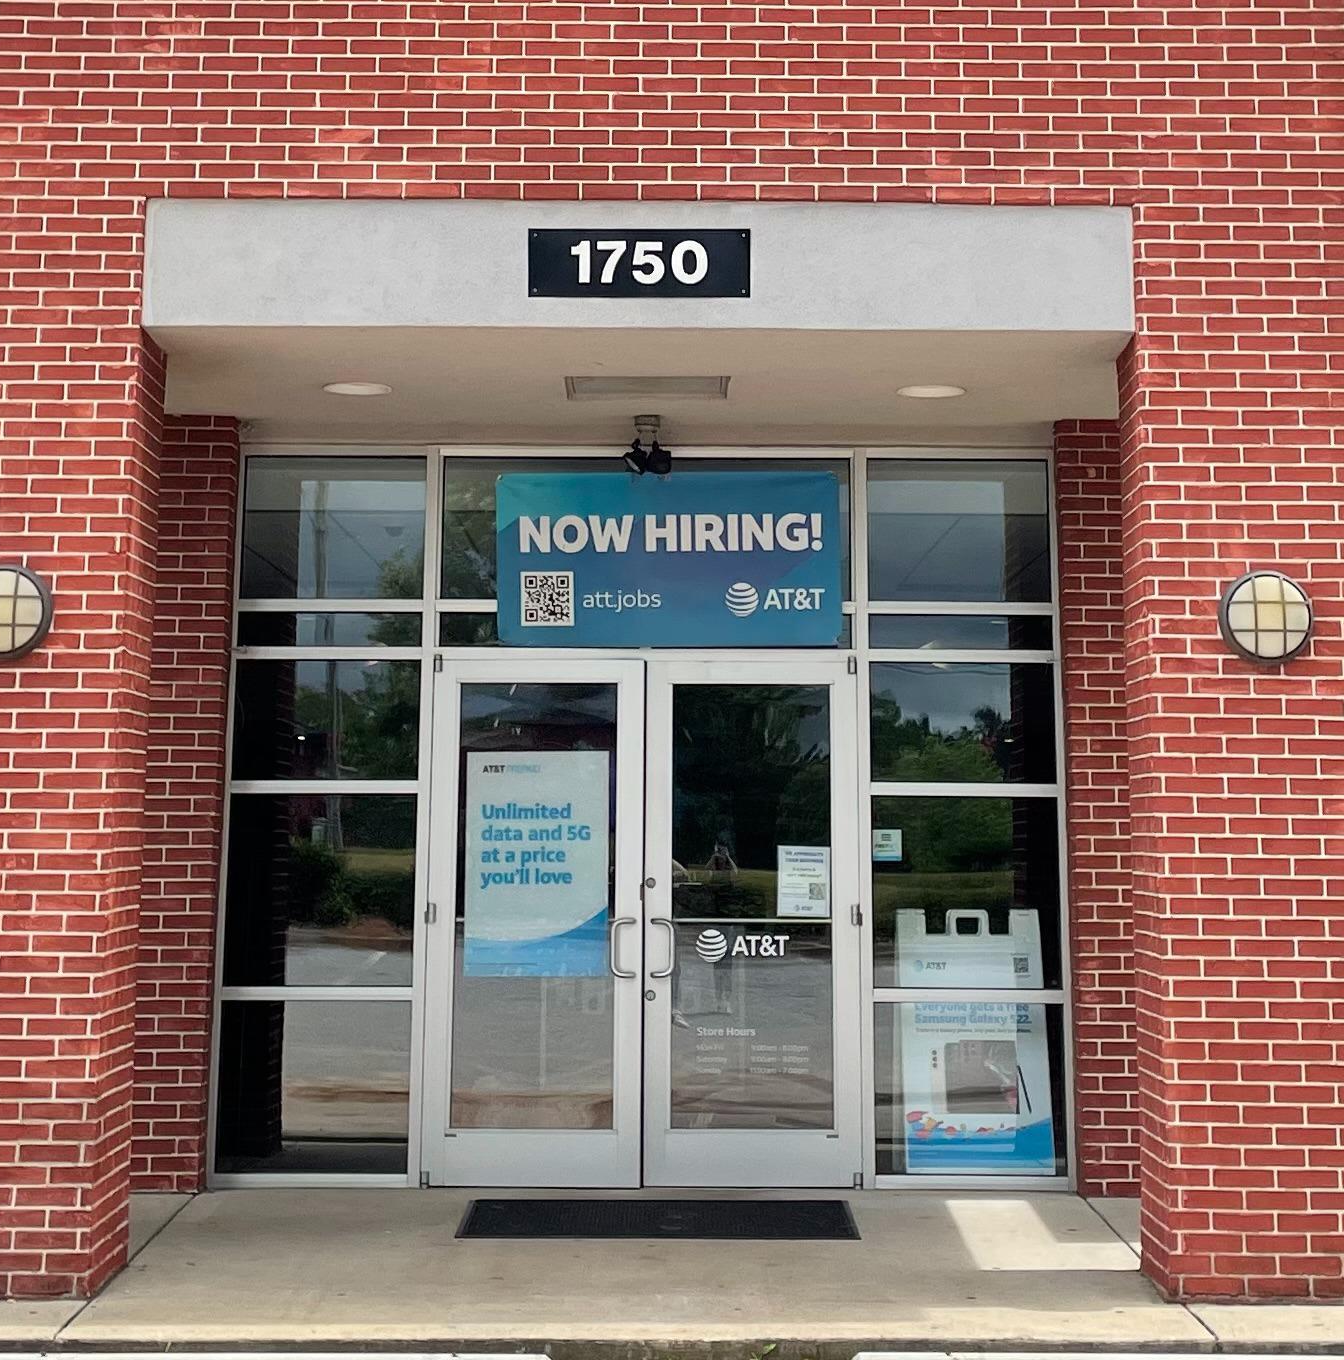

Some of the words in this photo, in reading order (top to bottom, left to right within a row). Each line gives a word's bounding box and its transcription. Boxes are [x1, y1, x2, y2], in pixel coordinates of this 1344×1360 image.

[570, 239, 709, 285] 1750
[519, 514, 634, 553] NOW
[644, 512, 824, 552] HIRING!
[582, 588, 662, 614] att.jobs
[763, 587, 826, 611] AT&T
[482, 764, 506, 774] AT&T
[481, 803, 572, 820] Unlimited
[480, 824, 523, 842] data
[528, 824, 562, 842] and
[567, 825, 591, 842] 5G
[480, 847, 500, 863] at
[505, 850, 516, 863] a
[520, 846, 566, 867] price
[480, 868, 530, 889] you'll
[535, 868, 573, 885] love
[731, 935, 790, 957] AT&T
[914, 1013, 967, 1026] Samsung
[969, 1013, 1007, 1026] Galaxy
[696, 1026, 724, 1037] Store
[725, 1027, 756, 1037] Hours
